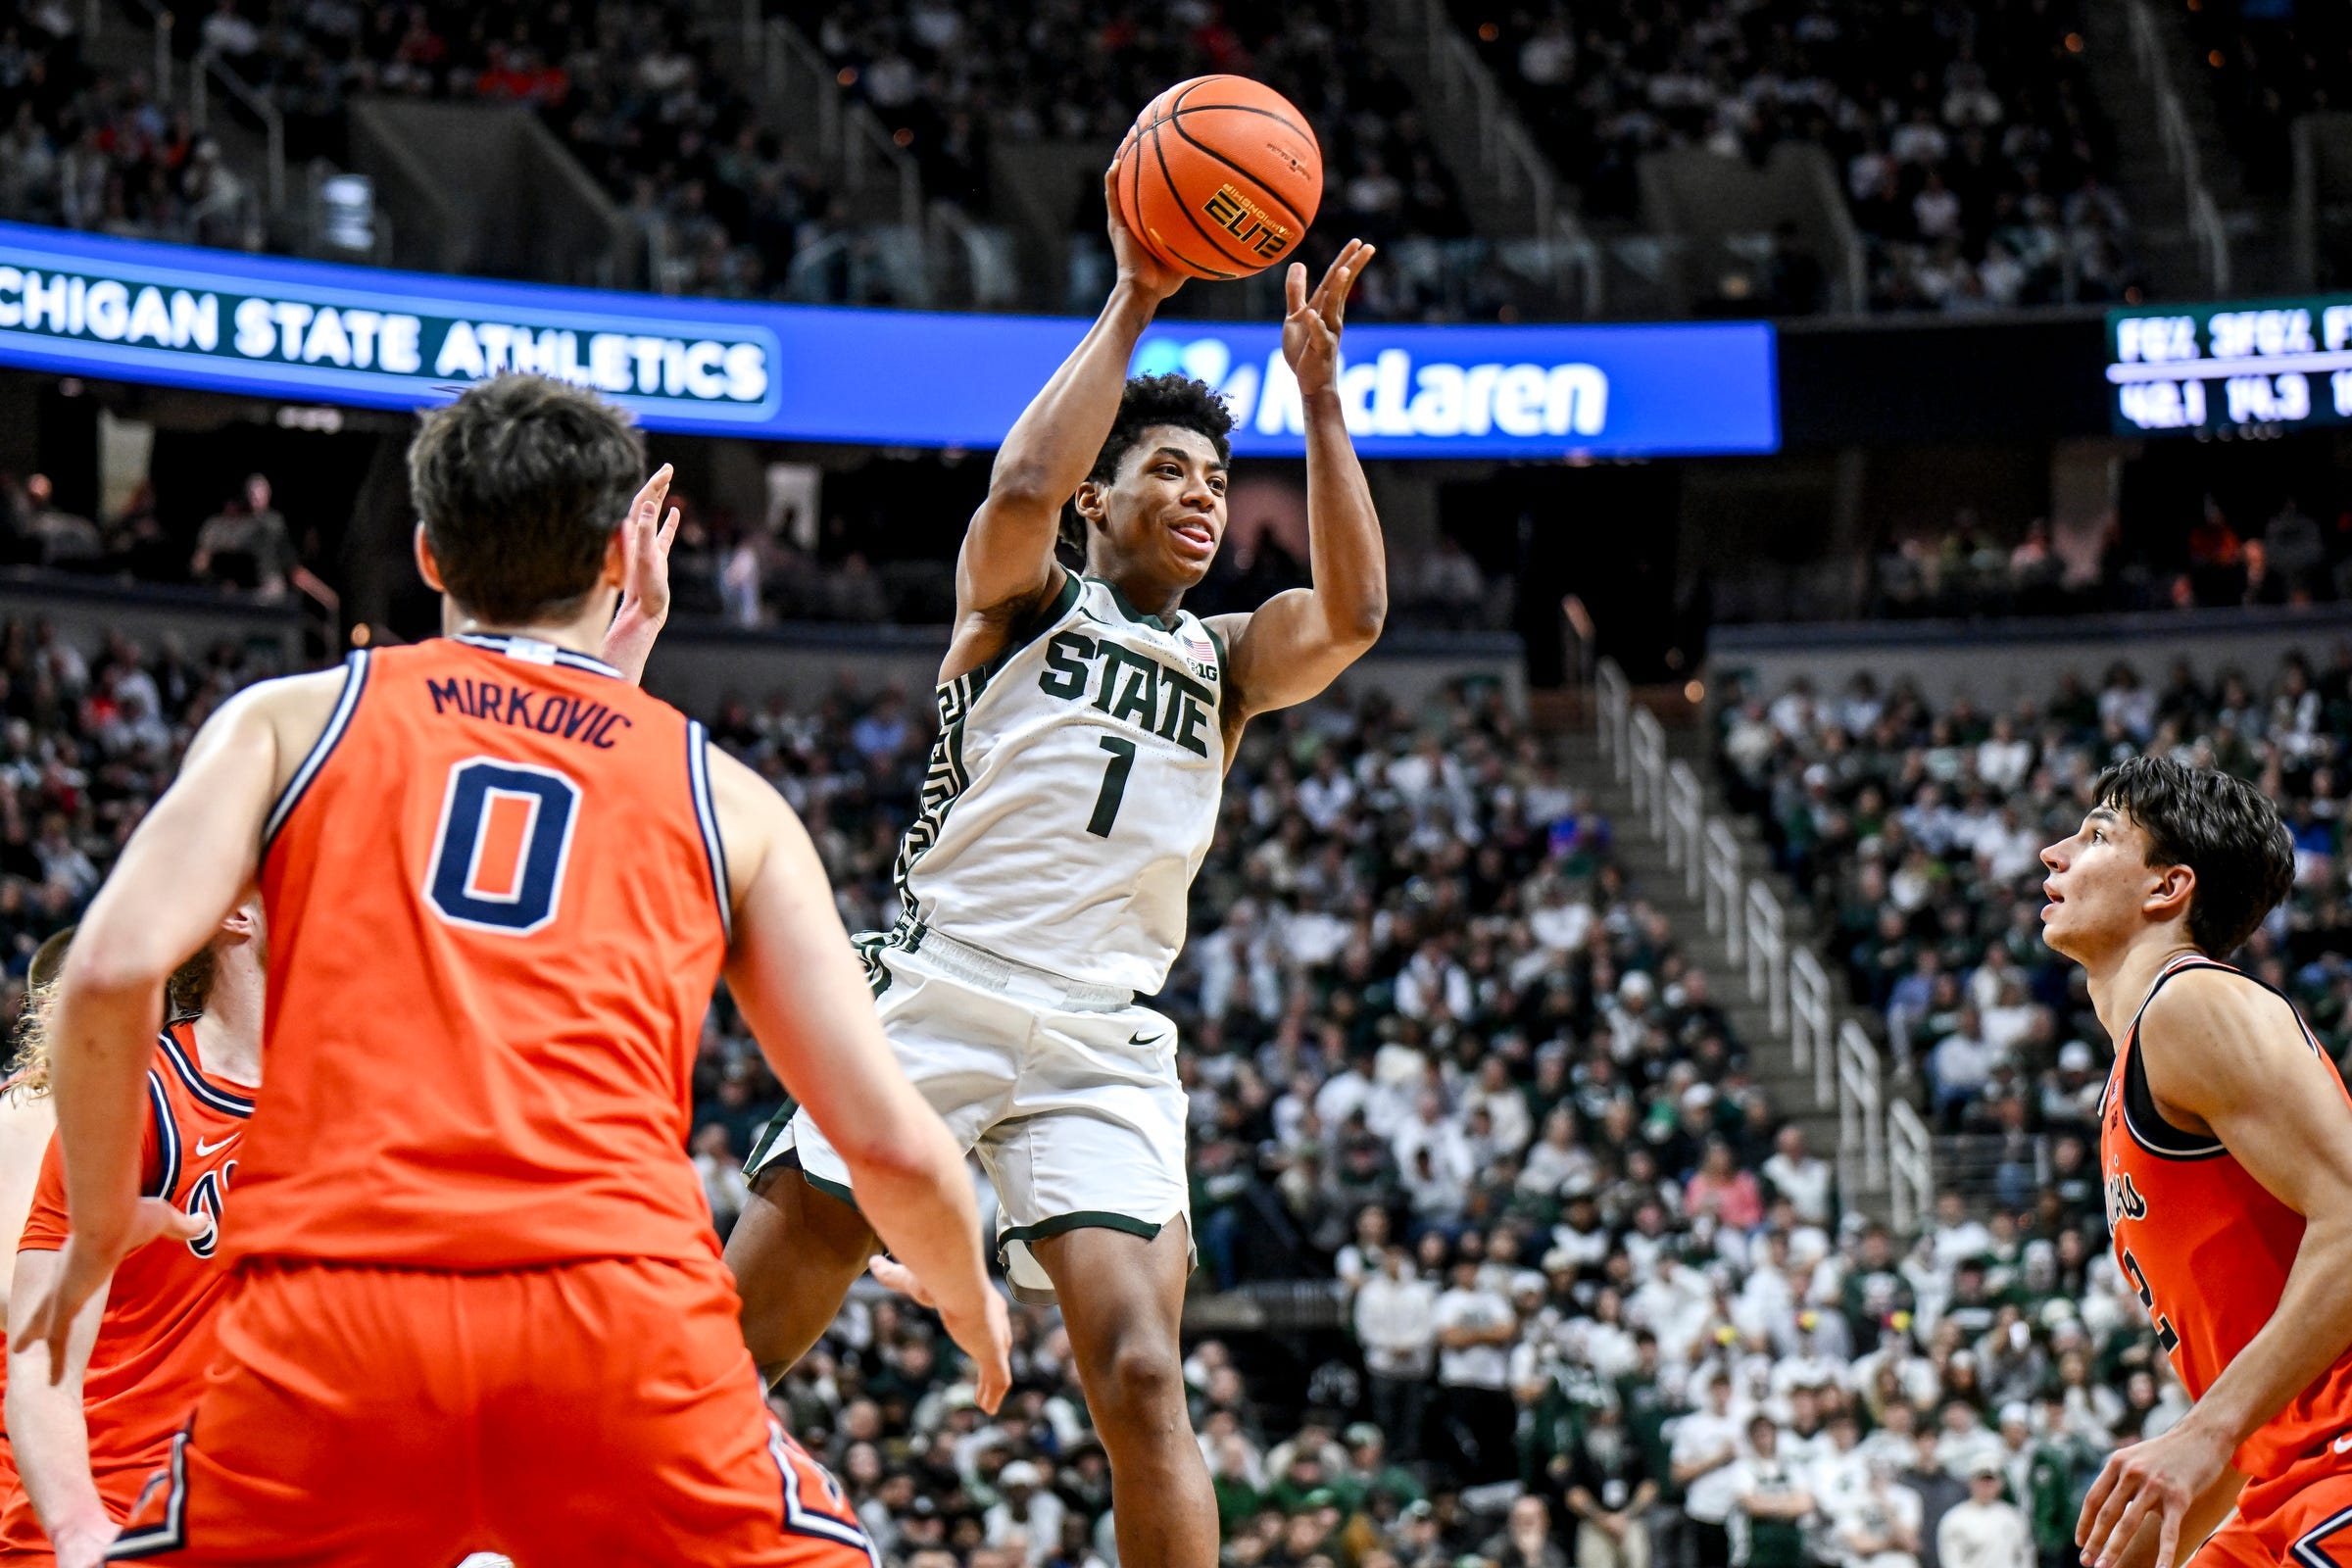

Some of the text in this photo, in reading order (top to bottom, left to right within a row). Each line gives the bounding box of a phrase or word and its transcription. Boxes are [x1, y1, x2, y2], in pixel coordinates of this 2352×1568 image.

[1201, 187, 1288, 260] ELITE
[233, 297, 421, 373] STATE
[434, 319, 767, 402] ATHLETICS
[426, 677, 632, 749] MIRKOVIC
[1039, 630, 1214, 759] STATE
[1086, 735, 1136, 839] 1
[421, 755, 583, 938] 0
